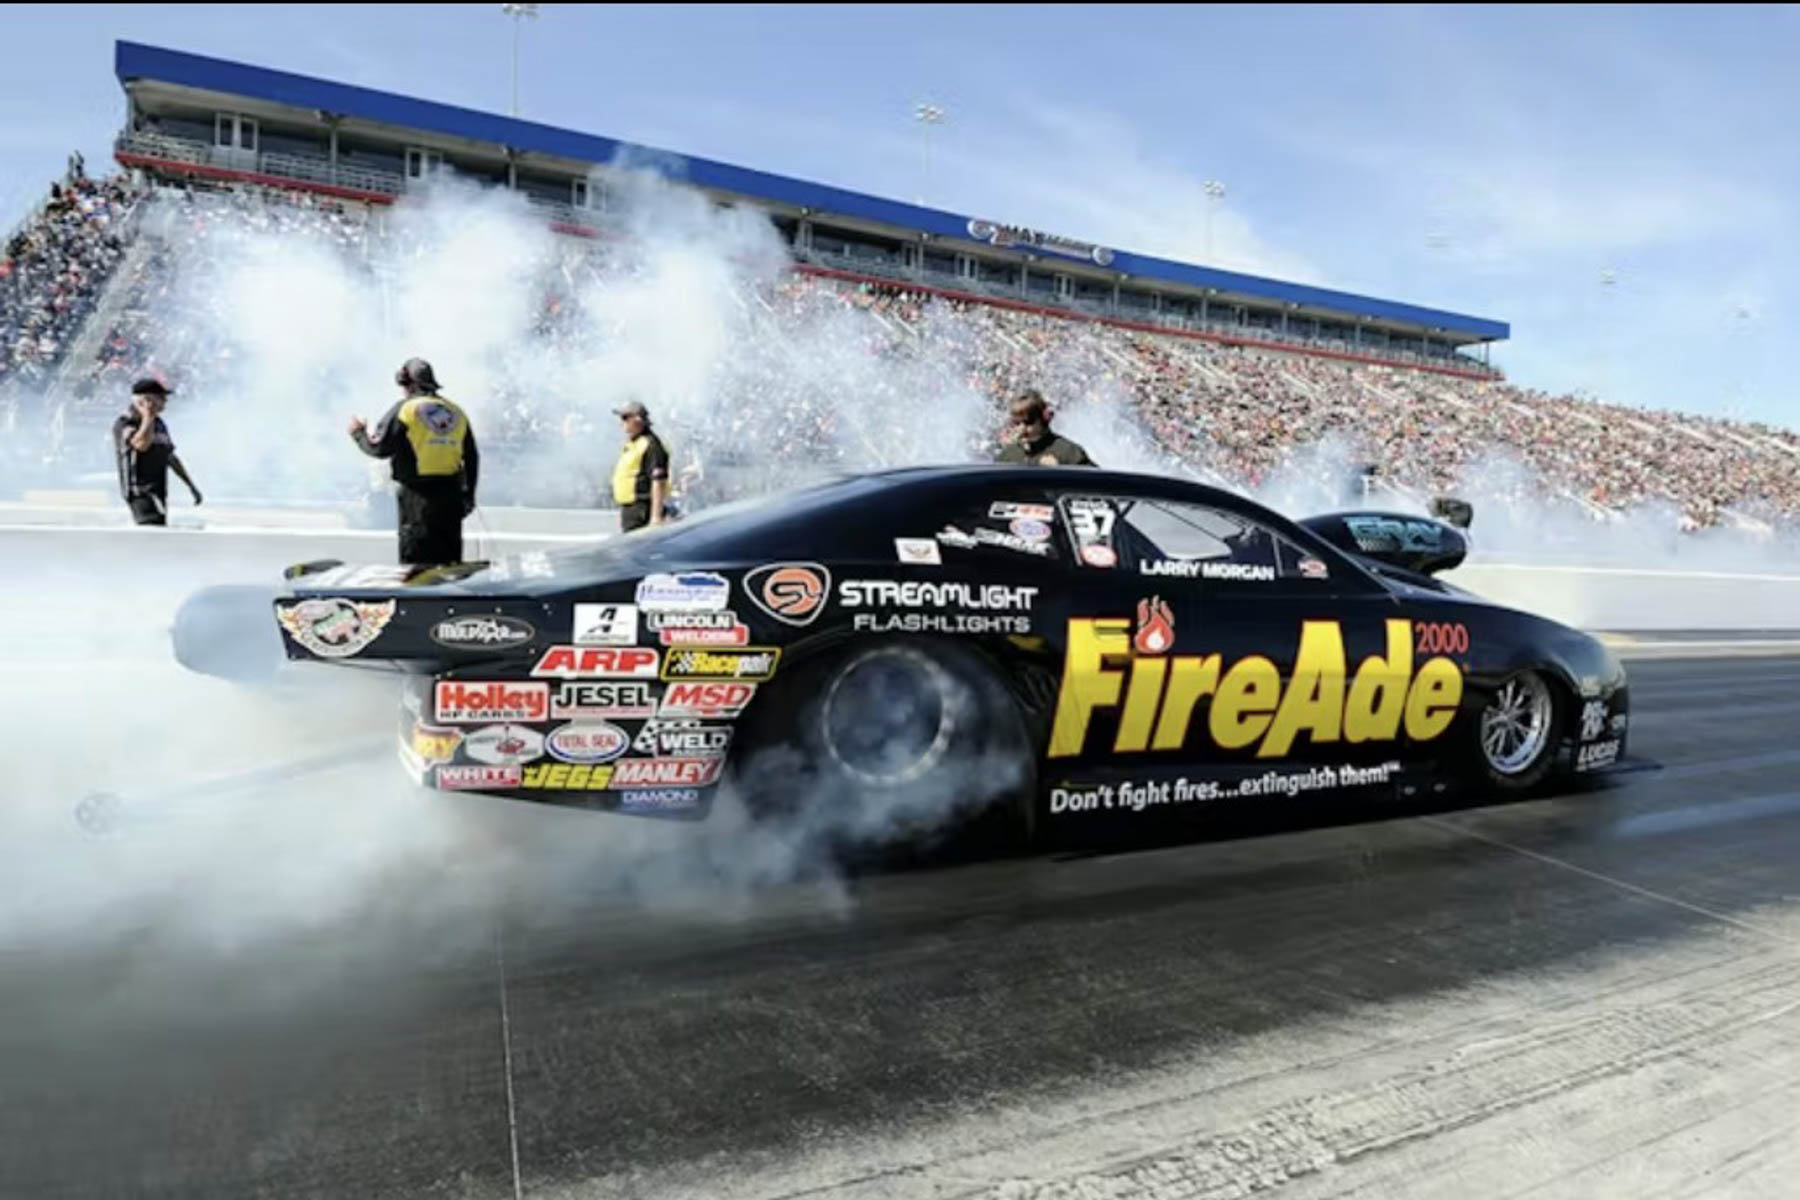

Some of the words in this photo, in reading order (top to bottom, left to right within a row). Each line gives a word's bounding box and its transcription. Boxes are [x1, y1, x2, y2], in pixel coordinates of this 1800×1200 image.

[1069, 508, 1116, 537] 37
[1140, 559, 1201, 577] LARRY
[1202, 562, 1275, 581] MORGAN
[839, 580, 1038, 609] STREAMLIGHT
[654, 614, 731, 628] LINCOLN
[854, 614, 1031, 633] FLASHLIGHTS
[1415, 622, 1469, 653] 2000
[538, 650, 657, 671] ARP
[693, 652, 774, 678] Racepak
[555, 686, 650, 707] JESEL
[668, 684, 752, 707] MSD
[1048, 617, 1463, 758] FireAde
[440, 684, 544, 717] Holley
[557, 735, 587, 748] TOTAL
[591, 735, 617, 748] SEAL
[659, 733, 727, 750] WELD
[524, 763, 615, 790] JEGS
[614, 763, 713, 782] MANLEY
[623, 789, 698, 803] DIAMOND
[1050, 783, 1115, 813] Don't
[1118, 778, 1170, 811] fight
